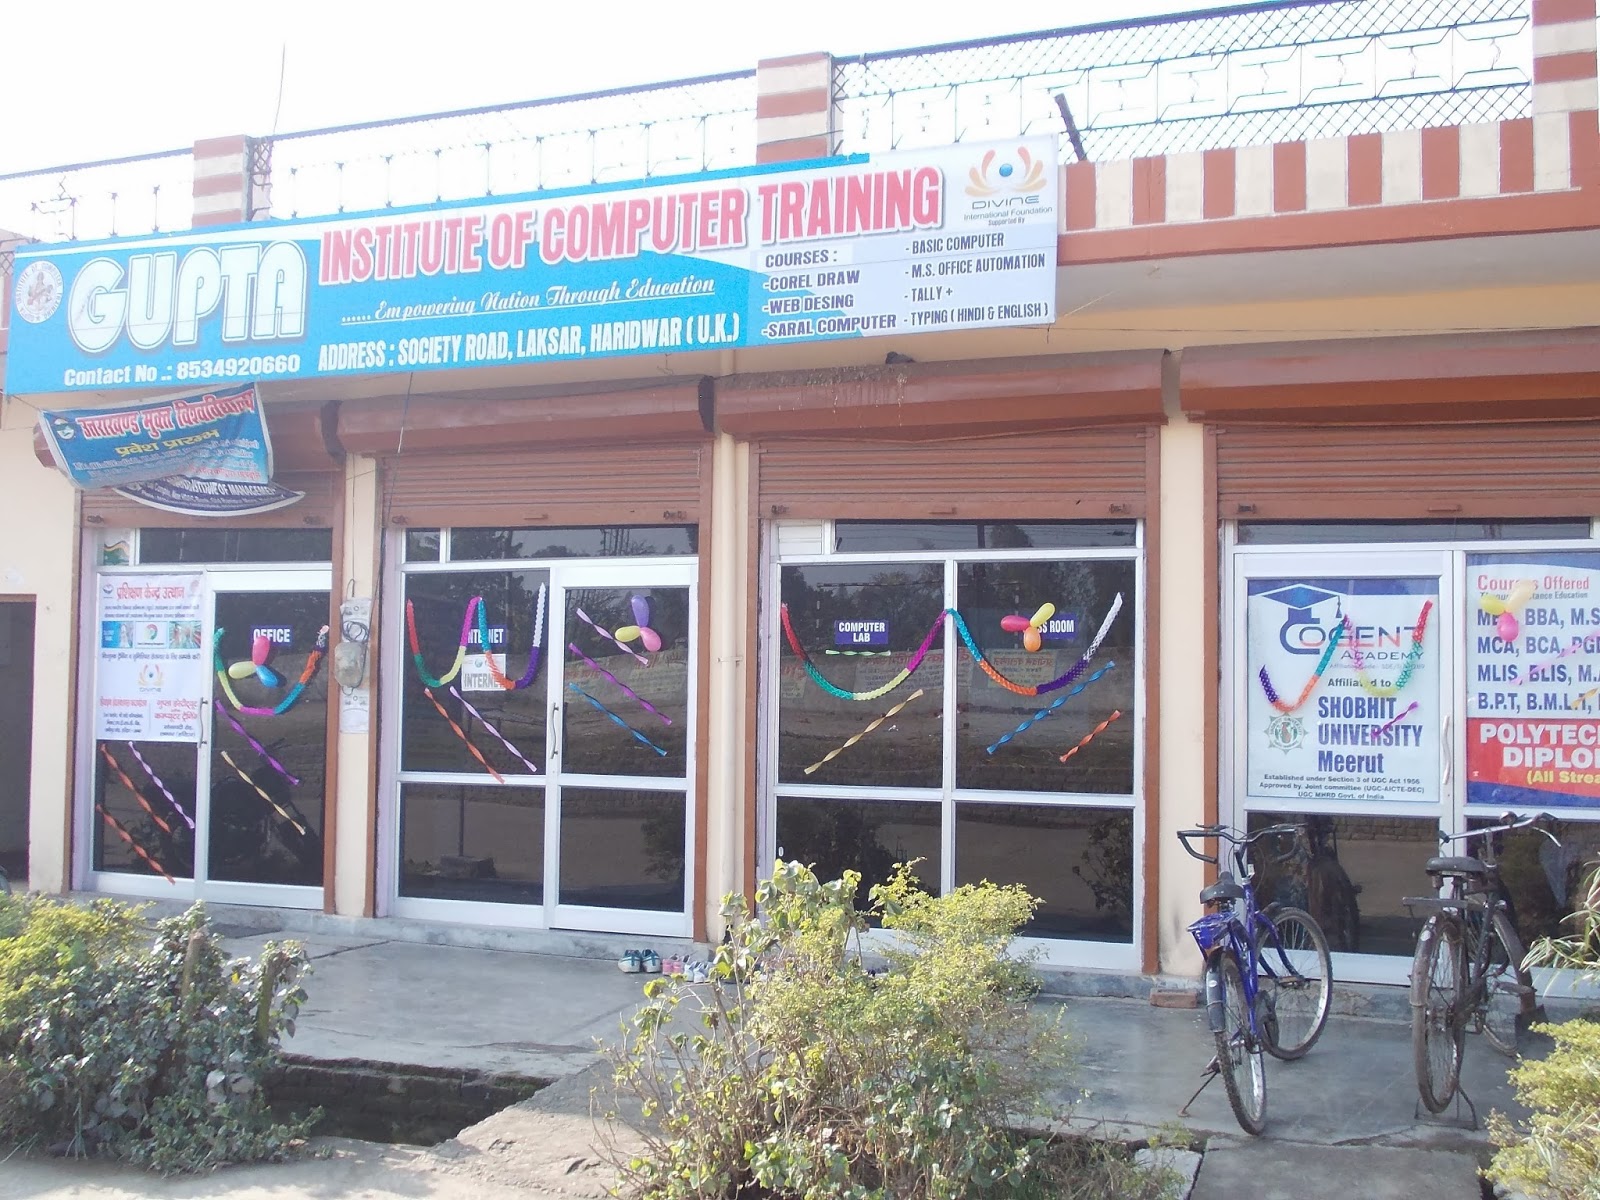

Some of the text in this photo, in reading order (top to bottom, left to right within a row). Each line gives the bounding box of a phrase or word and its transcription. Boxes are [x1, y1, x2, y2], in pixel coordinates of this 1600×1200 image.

[972, 195, 1039, 209] DIVINE
[964, 207, 1052, 221] International Foundation
[319, 165, 941, 284] INSTITUTE OF COMPUTER TRAINING
[912, 238, 943, 254] BASIC
[946, 232, 1004, 251] COMPUTER
[765, 250, 829, 267] COURSES
[911, 263, 935, 278] M.S.
[938, 260, 972, 276] OFFICE
[976, 253, 1045, 273] AUTOMATION
[817, 270, 860, 286] DRAW
[68, 239, 308, 353] GUPTA
[375, 300, 475, 322] Empowering
[481, 291, 540, 310] Nation
[546, 281, 620, 305] Through
[626, 275, 715, 298] Education
[804, 294, 854, 311] DESING
[911, 286, 942, 302] TALLY
[911, 309, 948, 326] TYPING
[957, 306, 985, 322] HINDI
[988, 306, 995, 320] &
[998, 302, 1041, 319] ENGLISH
[818, 314, 896, 333] COMPUTER
[318, 340, 386, 371] ADDRESS
[398, 335, 462, 366] SOCIETY
[465, 331, 512, 361] ROAD,
[516, 325, 586, 358] LAKSAR,
[590, 317, 682, 352] HARIDWAR
[64, 366, 131, 386] Contact
[176, 353, 300, 380] 8534920660
[114, 442, 160, 457] प्रवेश
[228, 484, 276, 496] MANAGEMEN
[1478, 574, 1589, 591] Cours Offered
[1555, 591, 1588, 599] Education
[838, 622, 885, 632] COMPUTER
[1049, 619, 1075, 633] ROOM
[1525, 608, 1564, 629] BBA,
[253, 628, 290, 643] OFFICE
[466, 628, 504, 644] NTENET
[852, 632, 871, 643] LAB
[1477, 636, 1519, 658] MCA,
[1572, 635, 1600, 654] PG
[1341, 650, 1425, 661] ACADEMY
[464, 672, 501, 688] INTERNE
[1578, 664, 1600, 682] M.
[1328, 679, 1392, 687] Affiliad to
[1318, 696, 1397, 719] SHOBHIT
[1478, 692, 1521, 714] B.P.T,
[1318, 723, 1423, 747] UNIVERSITY
[1480, 723, 1600, 745] POLYTEC
[1318, 750, 1385, 774] Meerut
[1503, 747, 1600, 769] DIPLO
[1527, 770, 1554, 784] (All
[1363, 785, 1425, 794] (UGC-AICTE-DEC)
